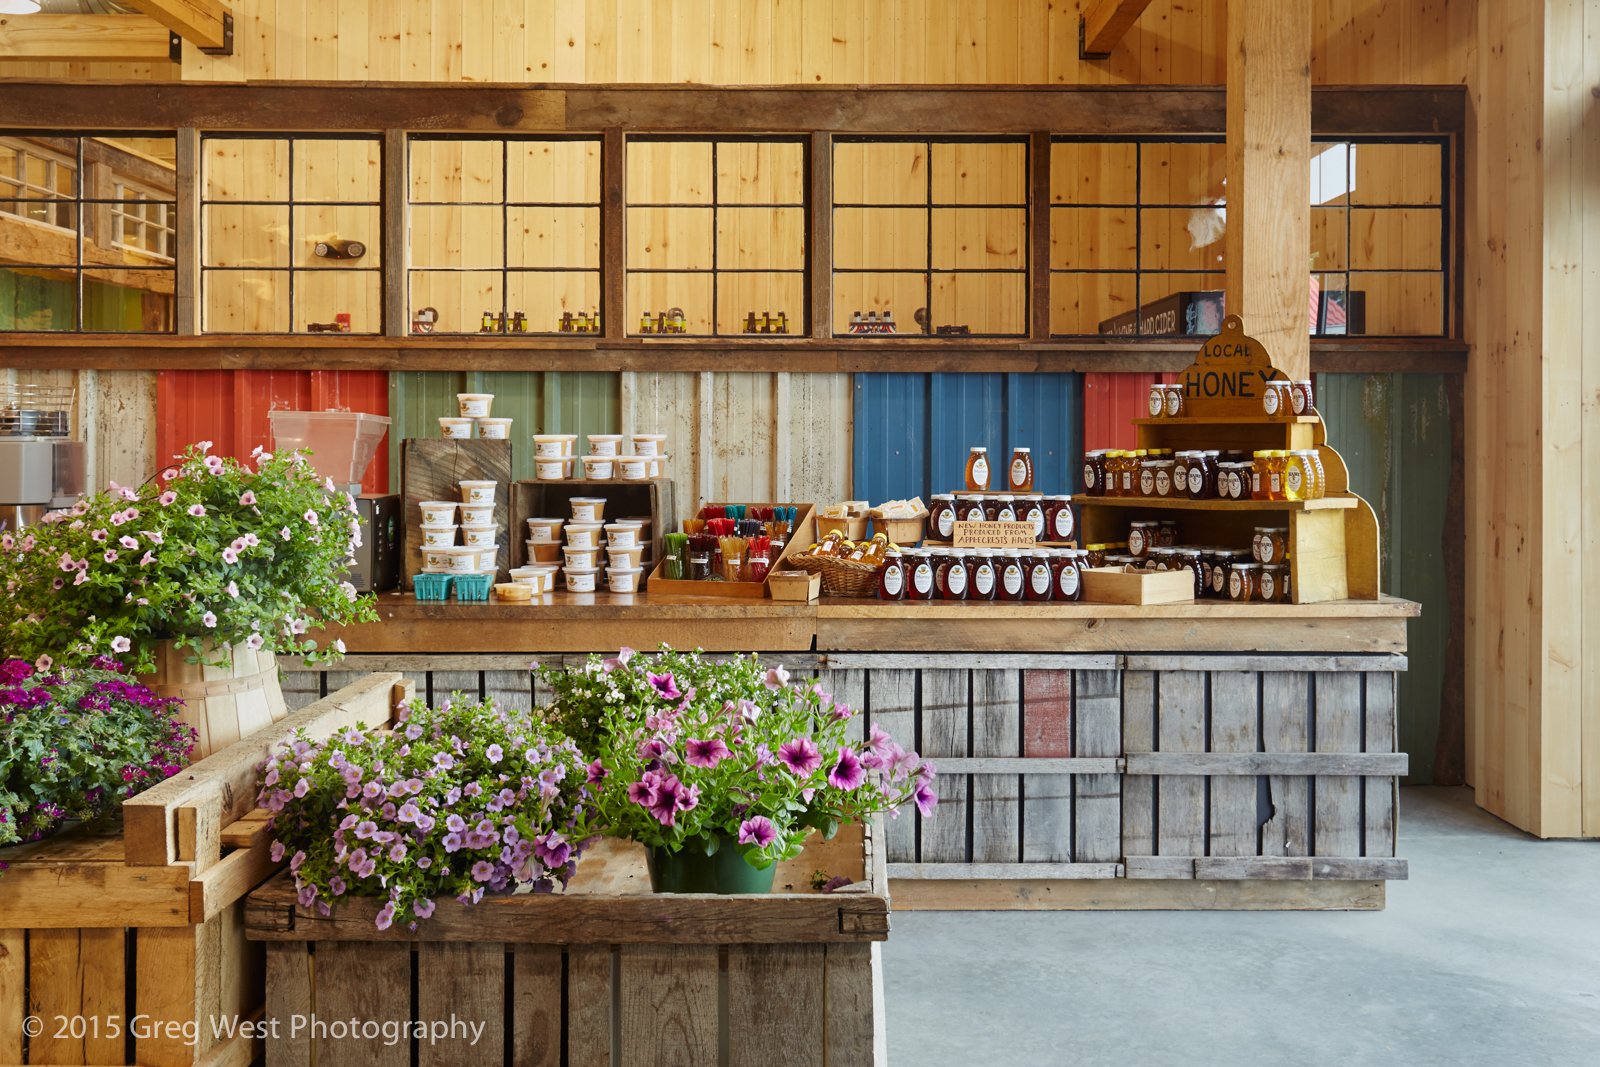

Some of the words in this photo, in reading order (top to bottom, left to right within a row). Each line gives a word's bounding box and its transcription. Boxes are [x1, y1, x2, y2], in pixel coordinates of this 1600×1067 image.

[1155, 309, 1176, 335] CIDER
[1204, 344, 1250, 357] LOCAL
[1186, 370, 1278, 397] HONEY
